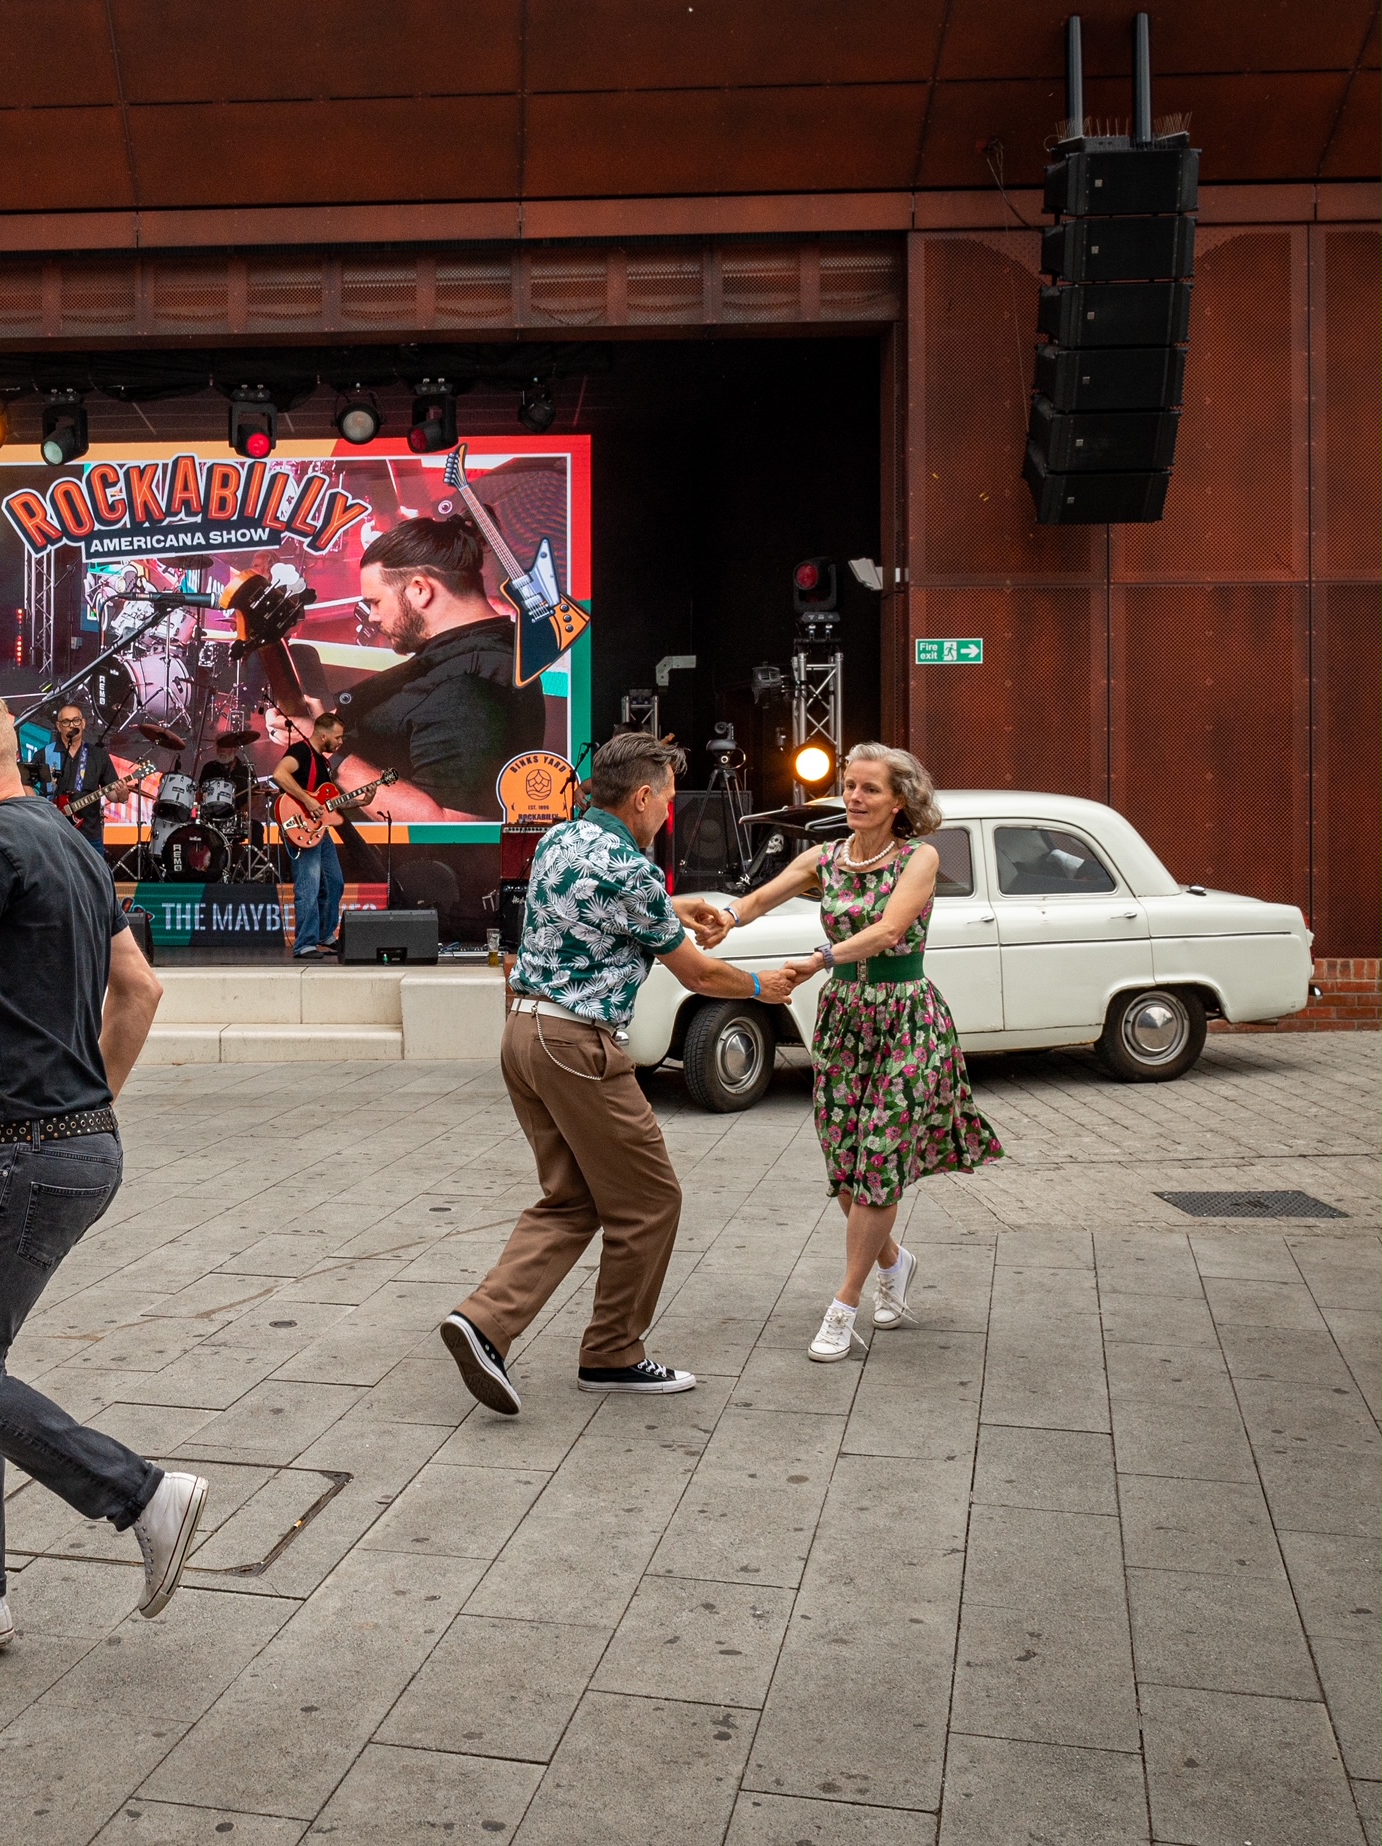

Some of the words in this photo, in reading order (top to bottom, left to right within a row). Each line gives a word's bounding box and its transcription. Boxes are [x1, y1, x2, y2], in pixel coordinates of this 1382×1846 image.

[7, 454, 370, 550] ROCKABILLY
[90, 532, 206, 553] AMERICANA
[209, 527, 270, 545] SHOW
[919, 642, 938, 651] Fire
[919, 651, 938, 660] exit
[510, 755, 538, 773] BINKS
[543, 756, 567, 773] YARD
[173, 843, 182, 872] REMO
[161, 903, 207, 931] THE
